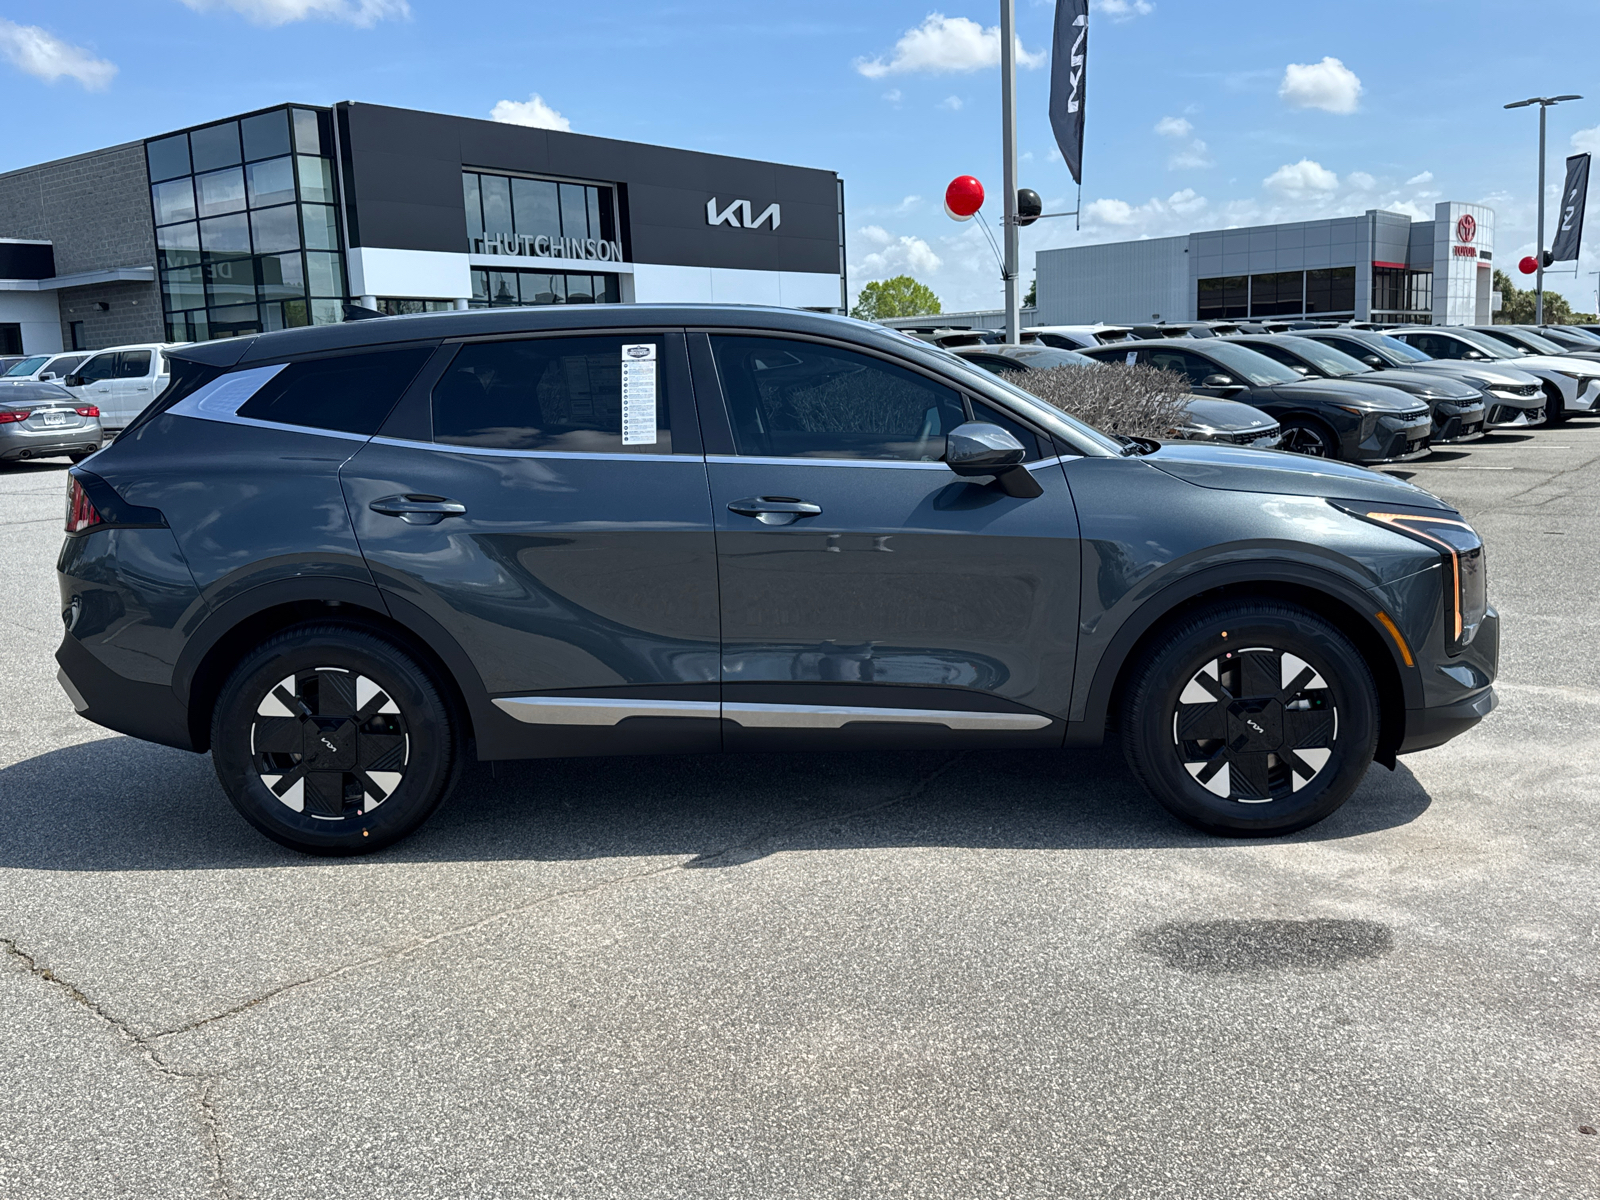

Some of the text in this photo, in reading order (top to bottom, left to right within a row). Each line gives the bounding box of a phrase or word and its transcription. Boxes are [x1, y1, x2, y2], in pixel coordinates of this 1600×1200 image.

[706, 196, 781, 231] KIA
[483, 231, 623, 263] HUTCHINSON
[1453, 245, 1477, 258] TOYOTA
